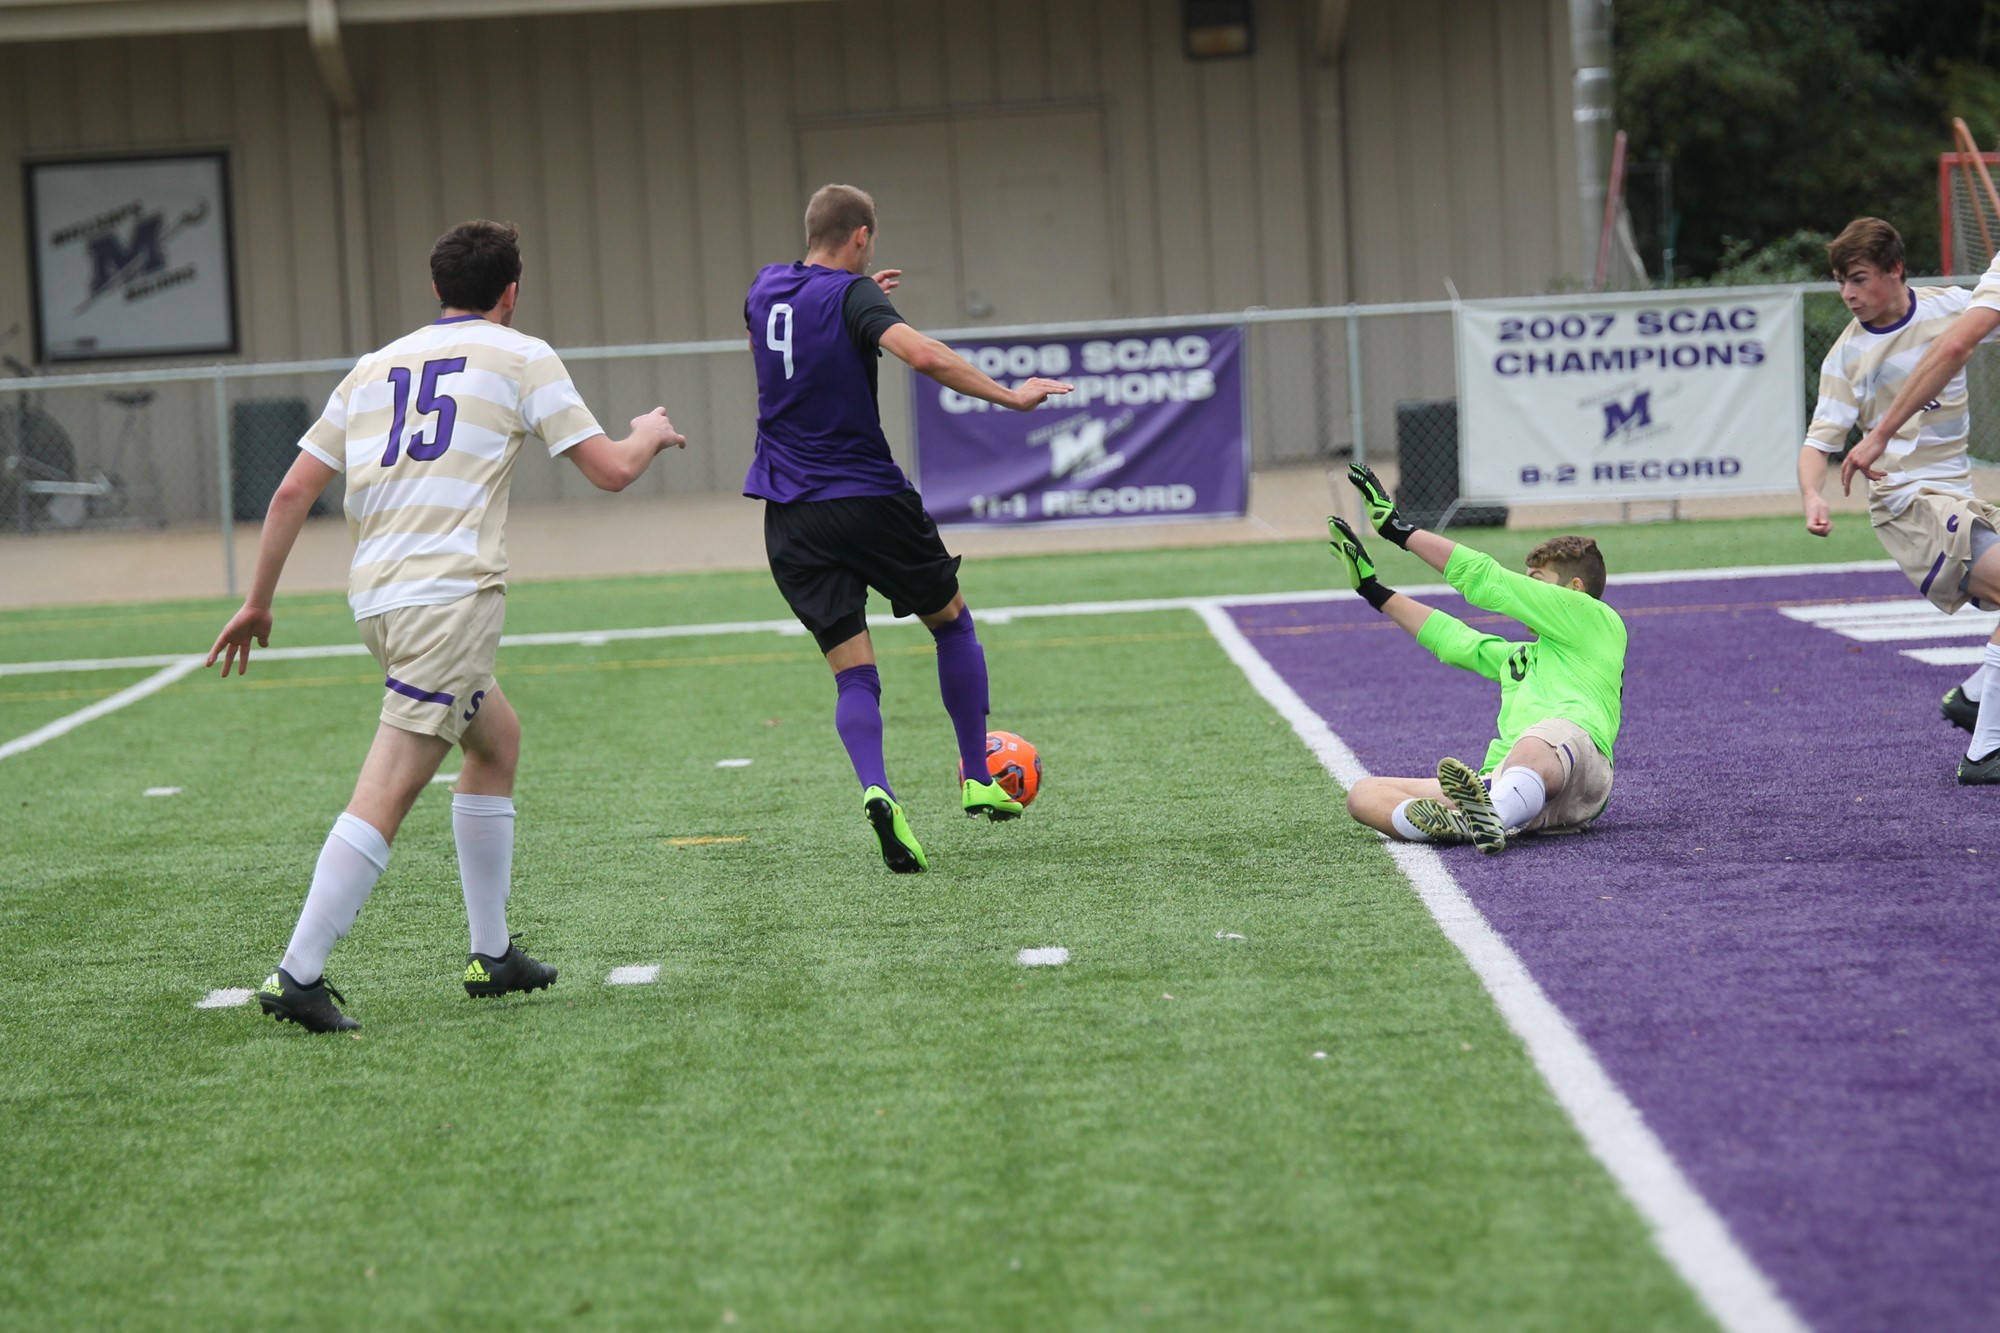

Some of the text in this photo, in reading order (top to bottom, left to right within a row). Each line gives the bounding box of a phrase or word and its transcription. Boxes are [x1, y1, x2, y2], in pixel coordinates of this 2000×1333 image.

[88, 209, 164, 295] M
[766, 303, 794, 380] 9
[1499, 307, 1758, 342] 2007 SCAC
[1080, 335, 1211, 373] SCAC
[1494, 342, 1766, 376] CHAMPIONS
[380, 356, 468, 467] 15
[938, 368, 1216, 415] CMPIONS
[1603, 388, 1652, 440] M
[1593, 457, 1742, 482] RECORD
[1040, 484, 1197, 517] RECORD
